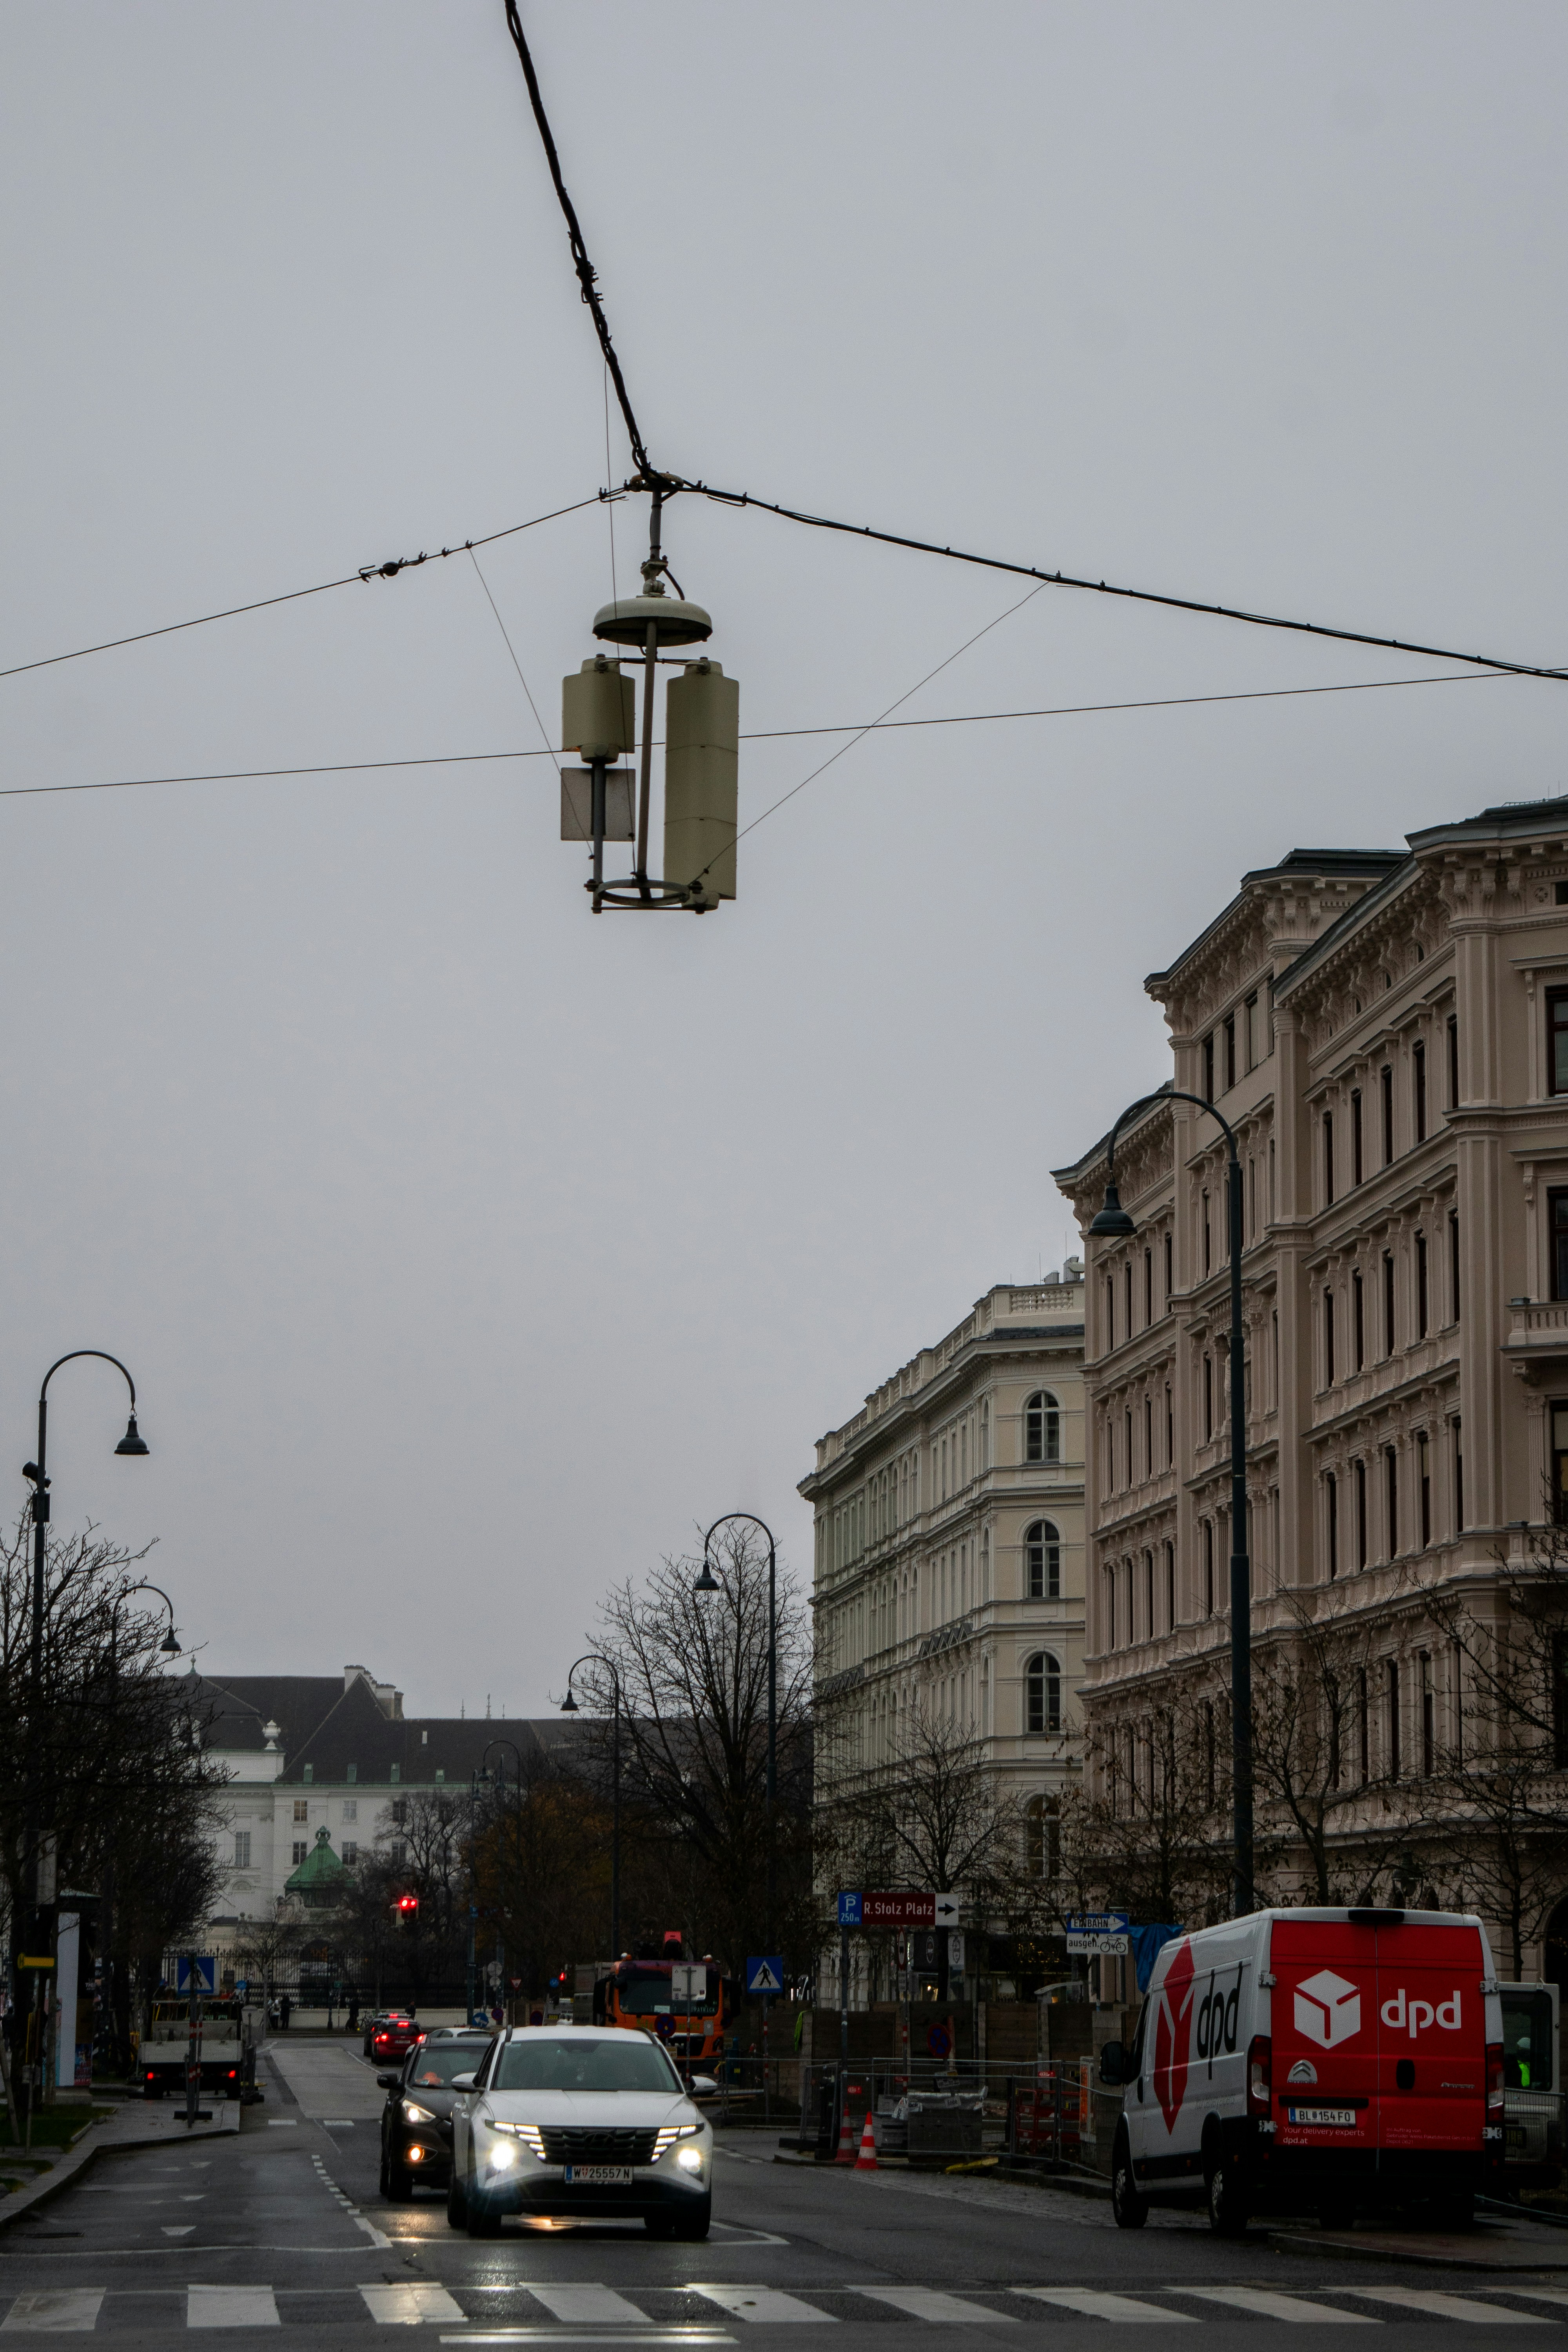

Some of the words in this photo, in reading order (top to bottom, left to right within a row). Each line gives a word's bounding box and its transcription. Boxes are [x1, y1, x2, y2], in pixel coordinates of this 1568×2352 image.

[875, 1902, 902, 1915] Stolz
[906, 1902, 933, 1915] Platz
[1074, 1918, 1108, 1927] EINBAHN
[1381, 1988, 1461, 2038] dpd
[1197, 1960, 1243, 2080] dpd
[1299, 2111, 1310, 2120] BL
[1319, 2111, 1335, 2121] 154
[1303, 2127, 1334, 2136] delivery
[1283, 2136, 1308, 2145] dpd.at
[573, 2168, 581, 2178] W
[589, 2168, 621, 2178] 25557
[623, 2168, 630, 2179] N
